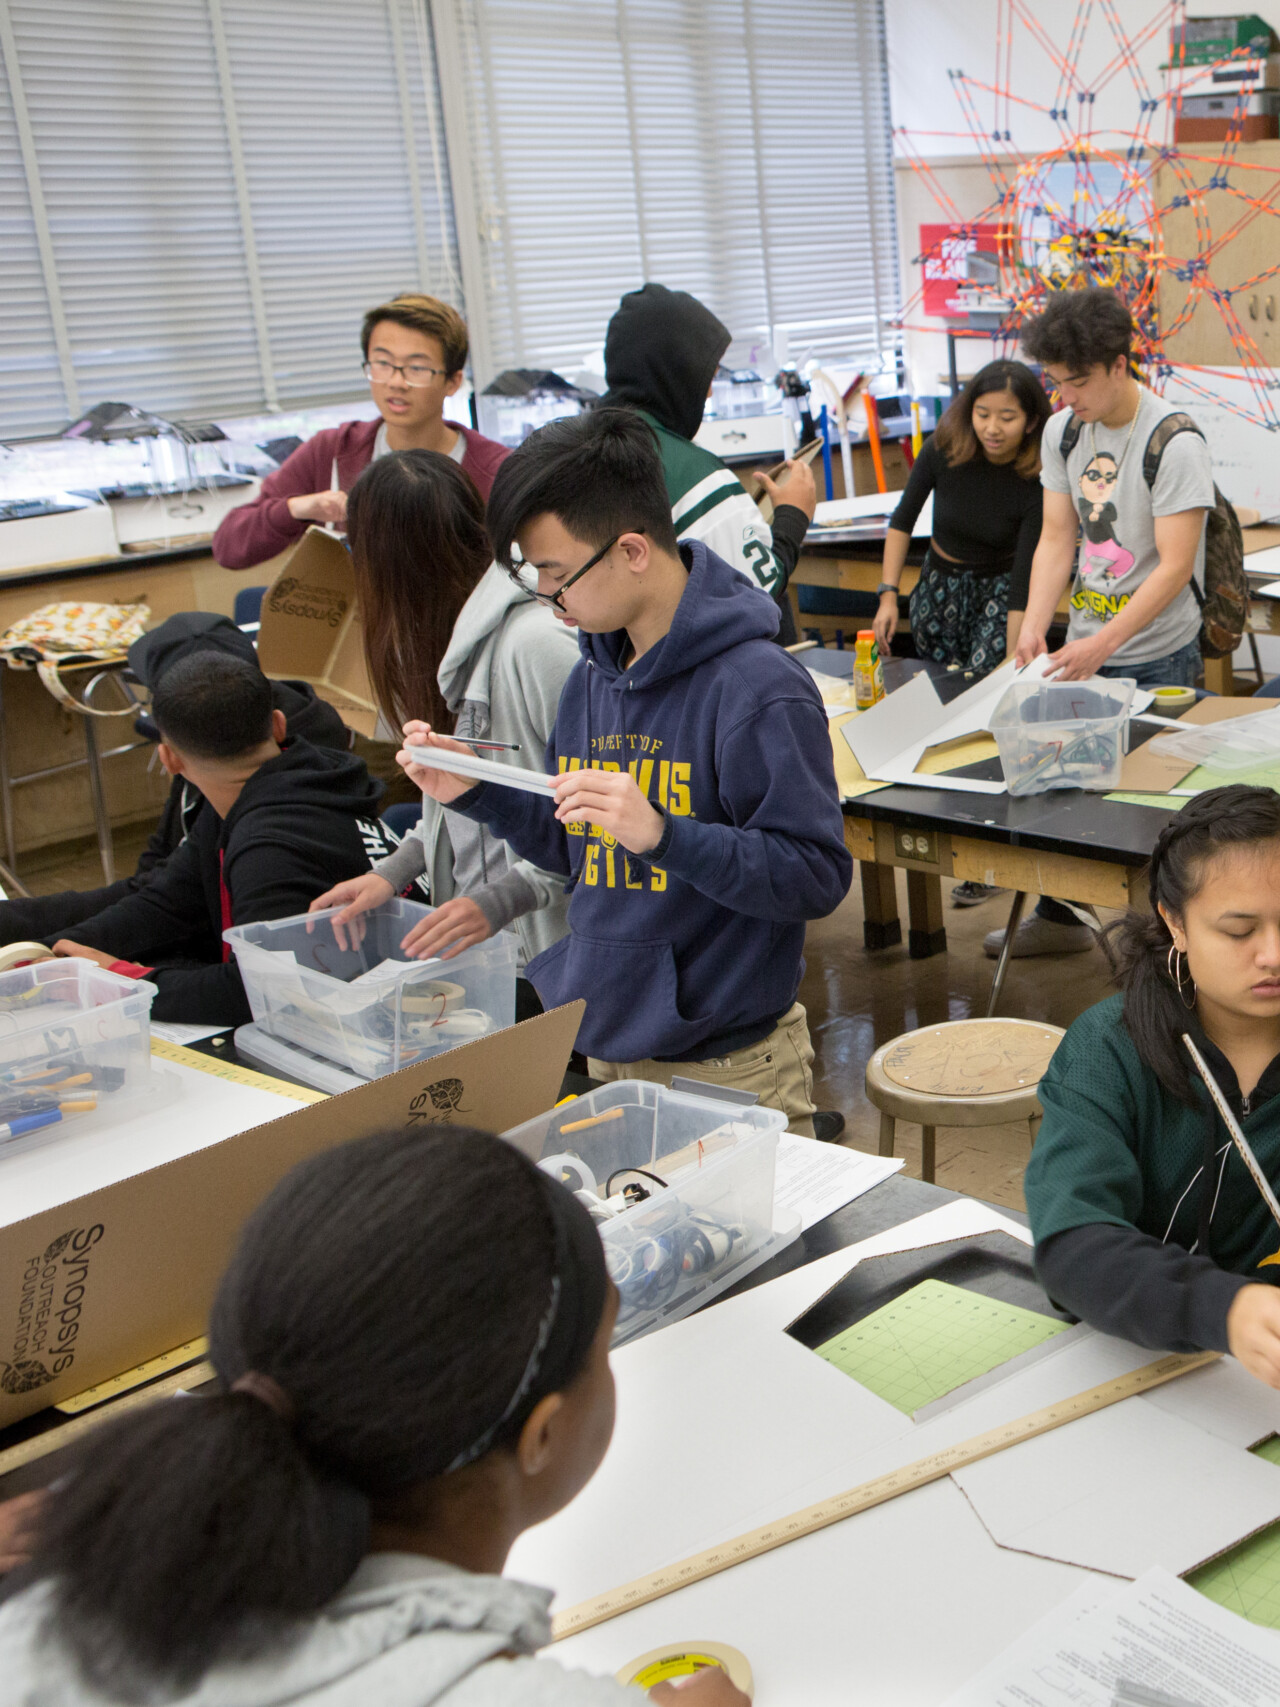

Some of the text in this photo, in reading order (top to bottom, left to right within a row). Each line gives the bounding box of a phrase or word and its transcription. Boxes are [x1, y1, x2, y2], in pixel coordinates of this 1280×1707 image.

[429, 991, 449, 1029] 2
[12, 1256, 41, 1363] FOUNDATION
[31, 1265, 57, 1353] OUTREACH
[49, 1223, 105, 1373] Synopsys
